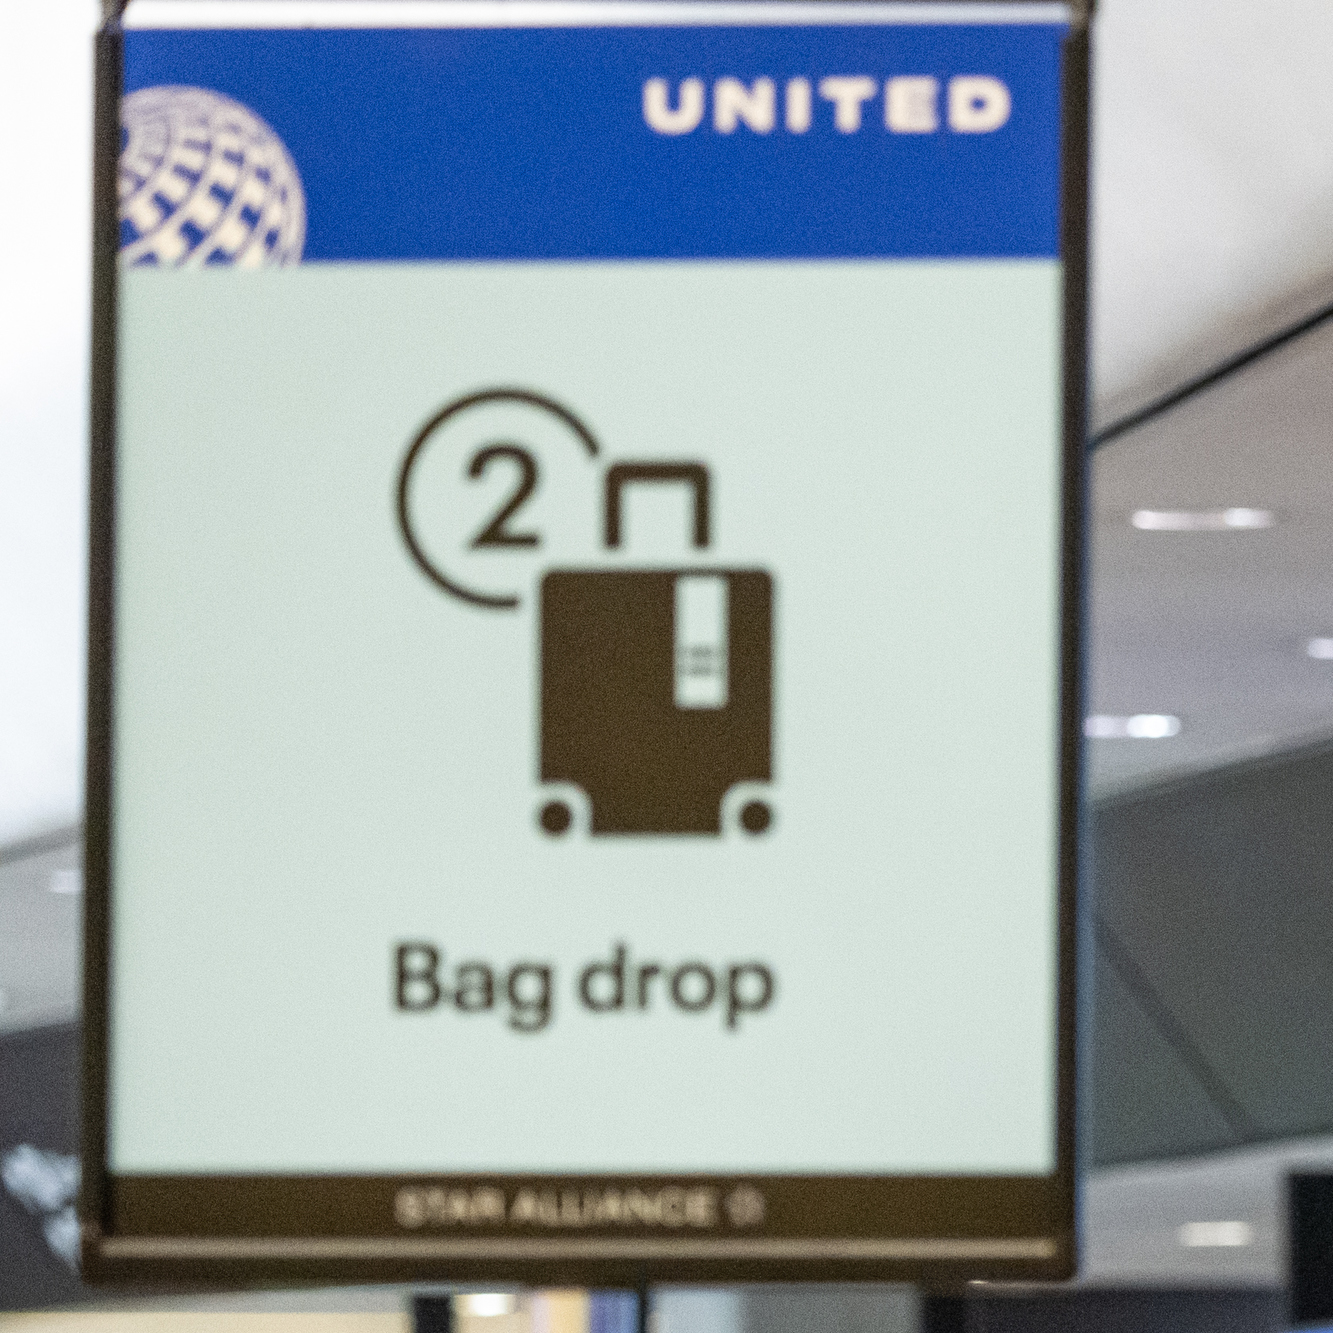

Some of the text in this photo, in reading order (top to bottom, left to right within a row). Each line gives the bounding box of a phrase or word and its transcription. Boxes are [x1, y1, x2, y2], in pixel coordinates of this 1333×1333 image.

[643, 75, 1011, 136] UNITED
[466, 440, 541, 549] 2
[394, 940, 775, 1035] Bag drop
[395, 1185, 721, 1228] STAR ALLIANCE
